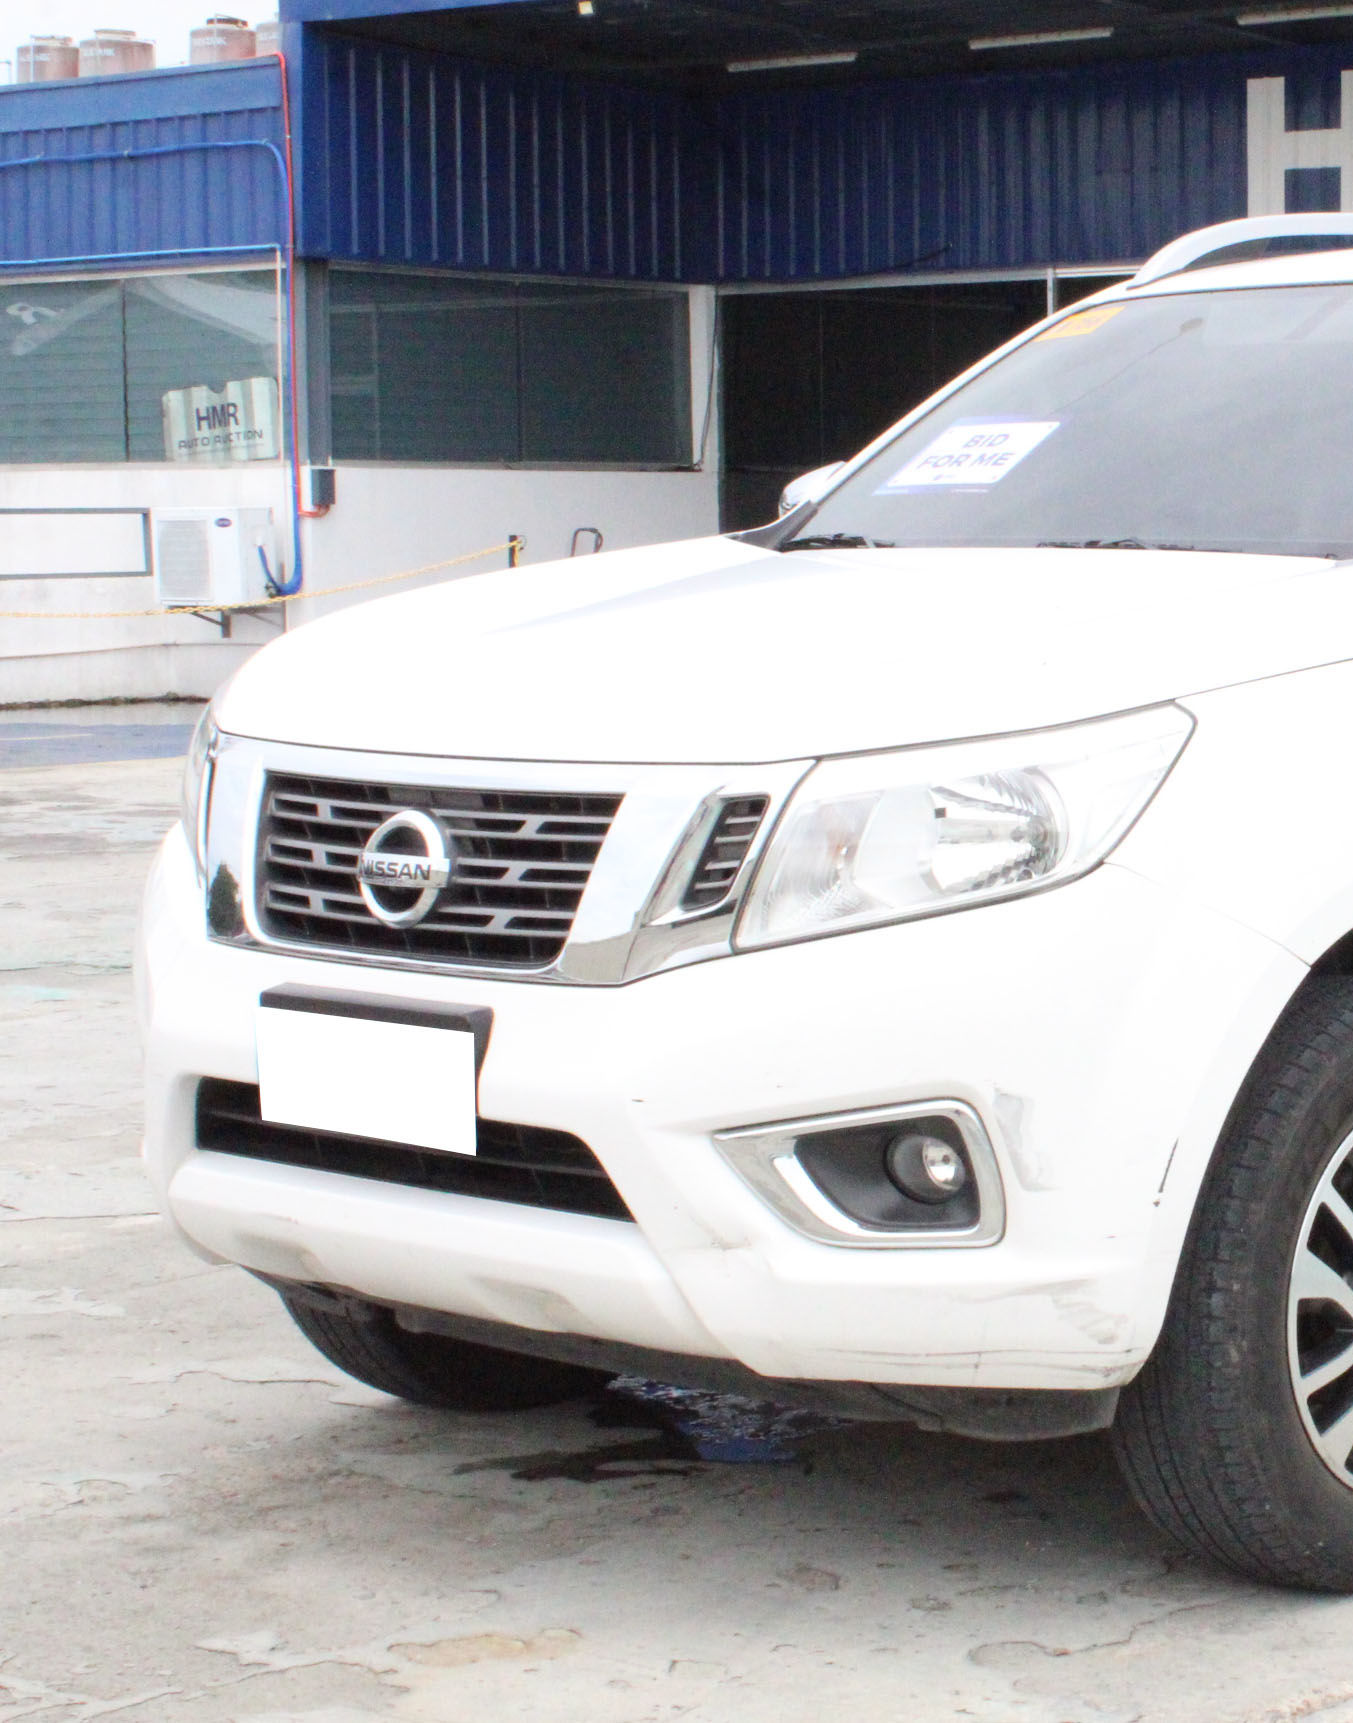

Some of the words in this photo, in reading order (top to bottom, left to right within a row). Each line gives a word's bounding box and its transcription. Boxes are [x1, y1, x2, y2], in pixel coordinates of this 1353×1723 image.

[194, 402, 240, 432] HMR
[177, 436, 211, 451] AUTO
[961, 432, 1010, 449] BID
[915, 453, 972, 471] FOR
[969, 451, 1015, 468] ME
[362, 858, 432, 882] NISSAN
